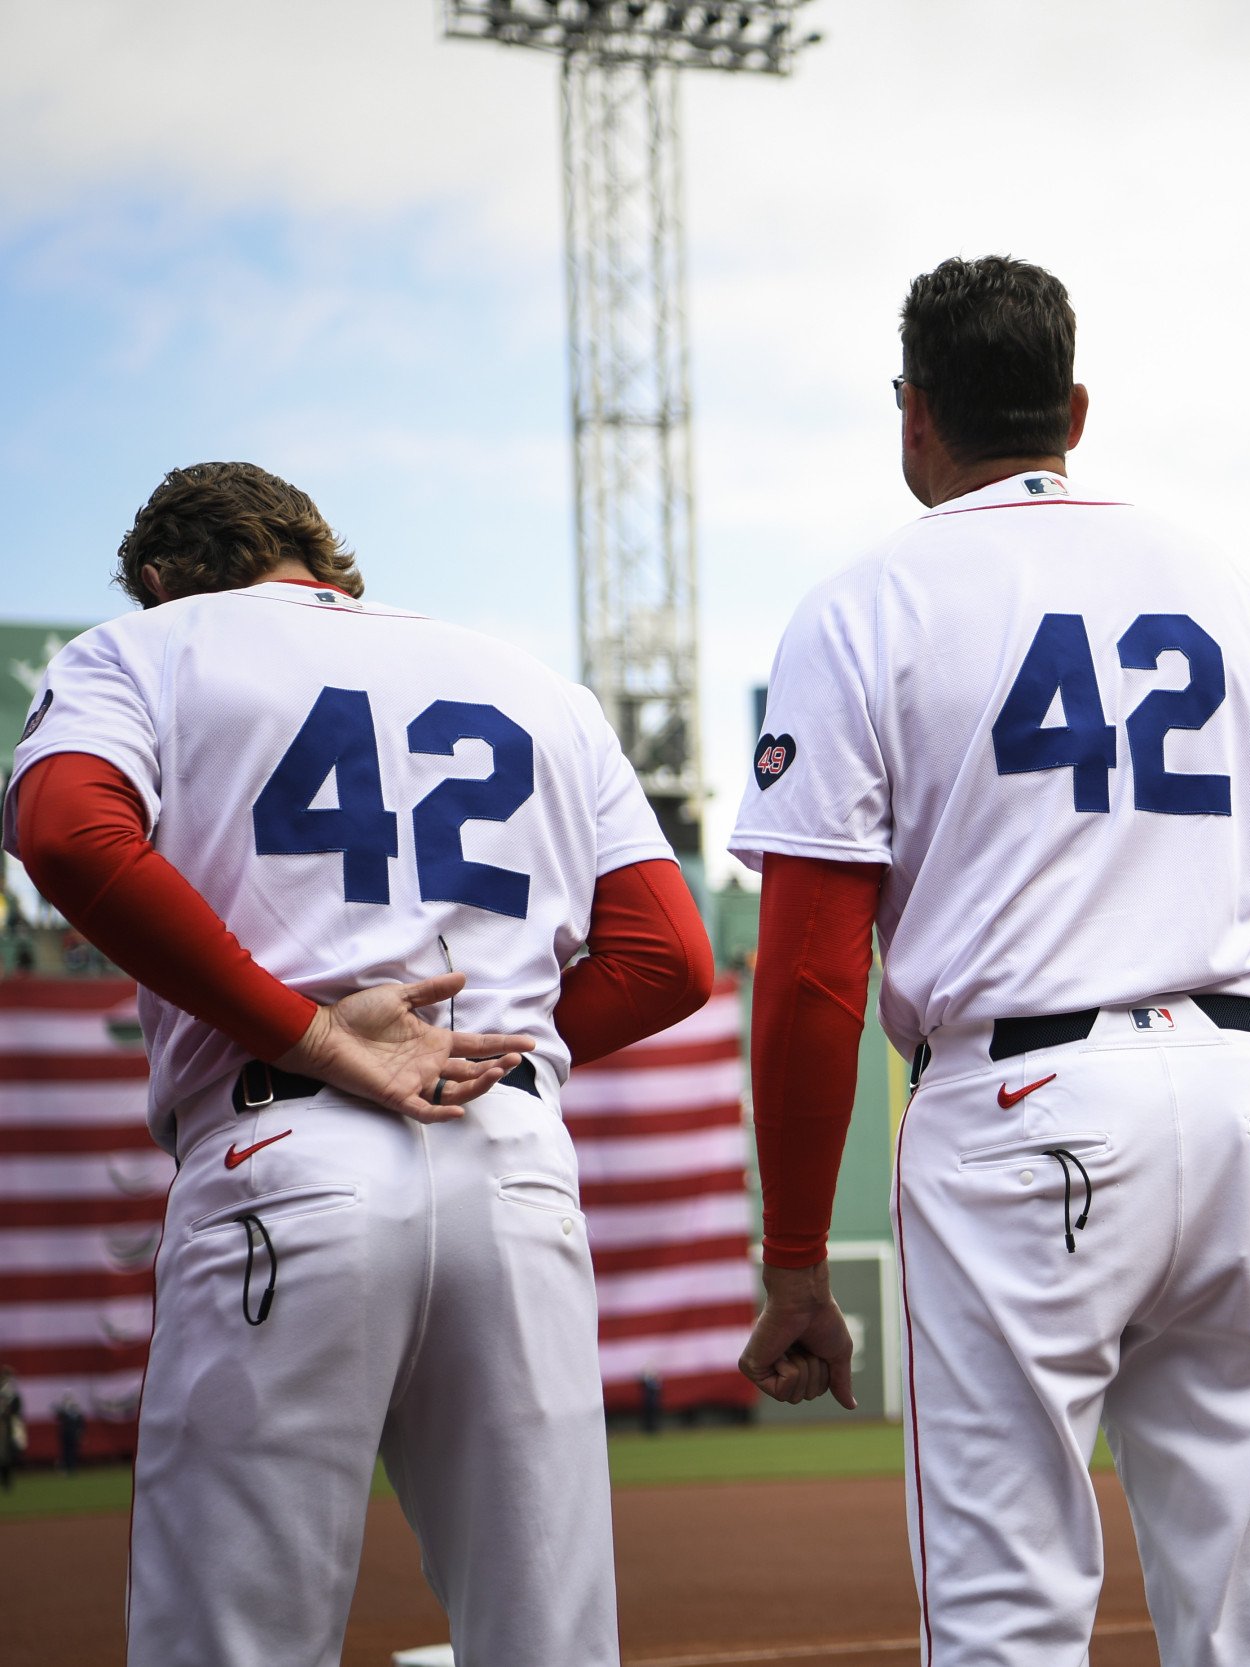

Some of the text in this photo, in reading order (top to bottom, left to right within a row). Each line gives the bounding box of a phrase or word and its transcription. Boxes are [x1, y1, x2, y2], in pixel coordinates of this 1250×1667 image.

[252, 686, 535, 919] 42
[757, 746, 786, 774] 49
[992, 614, 1232, 816] 42
